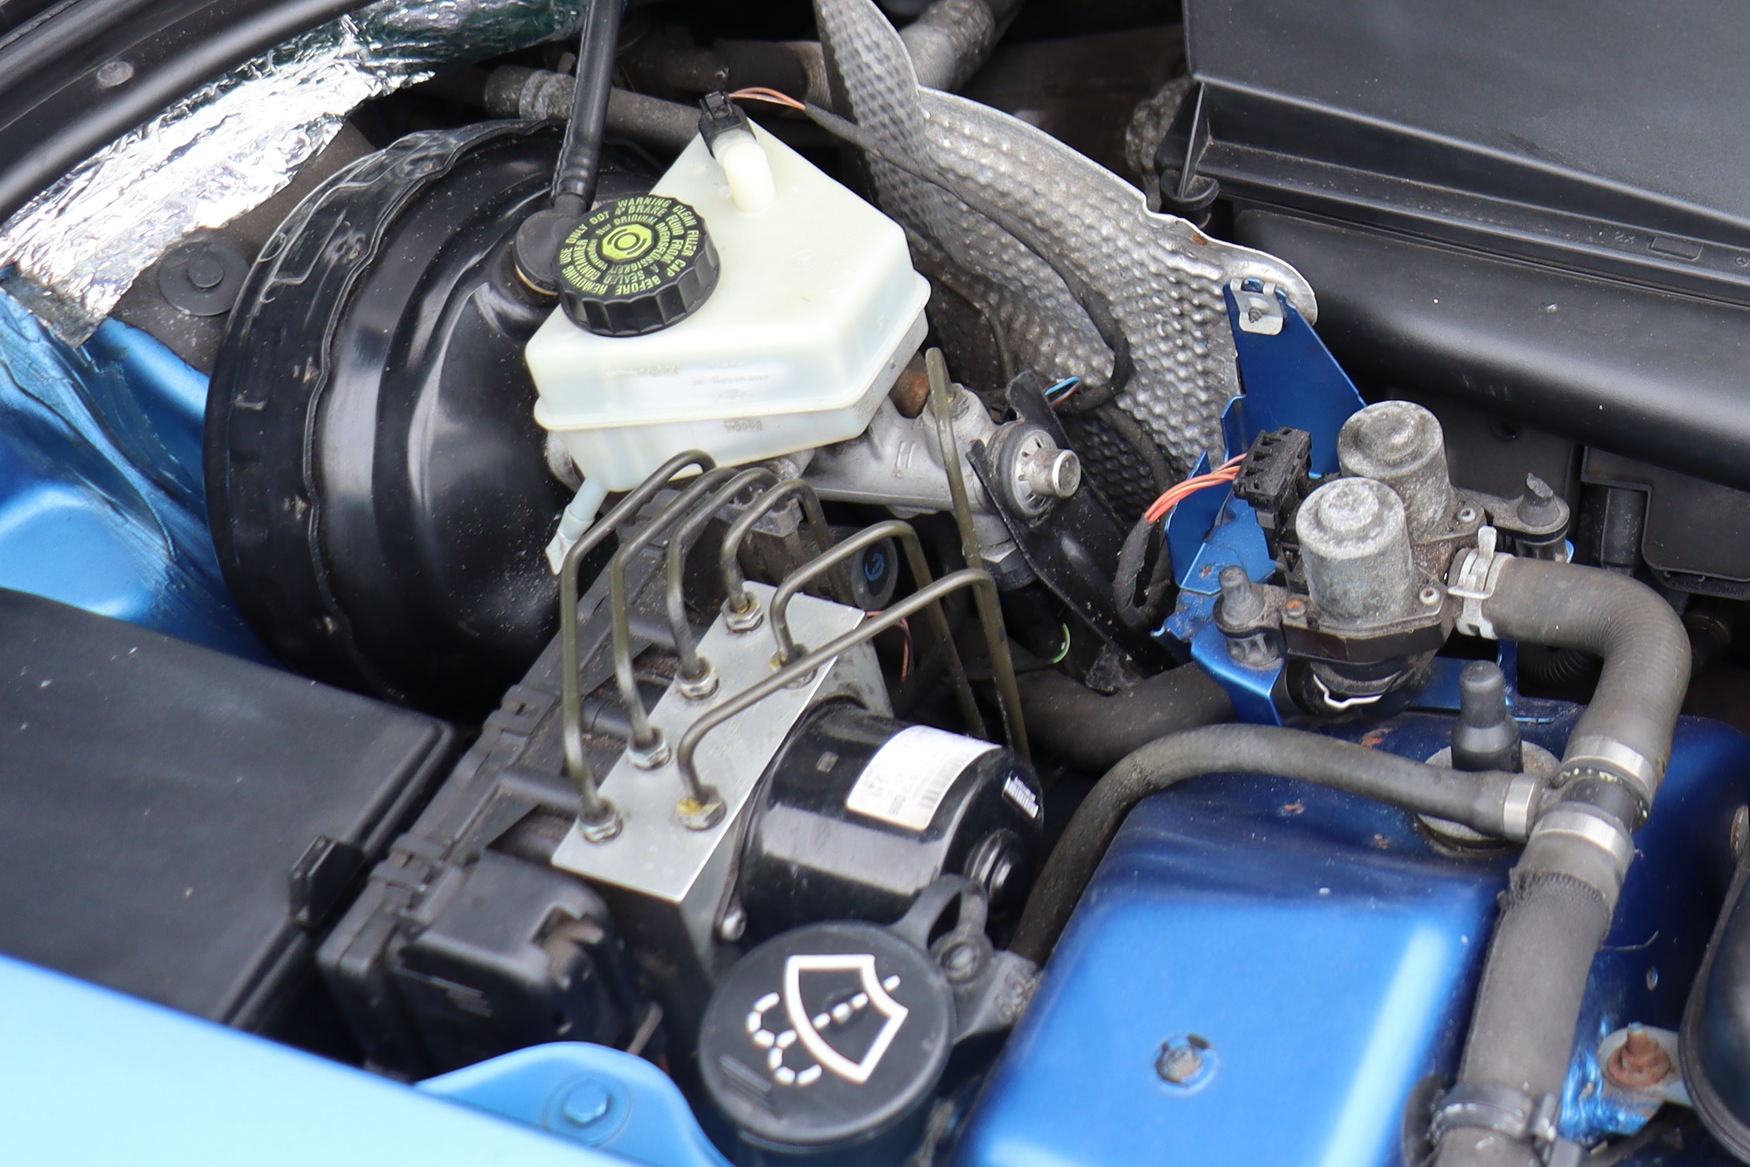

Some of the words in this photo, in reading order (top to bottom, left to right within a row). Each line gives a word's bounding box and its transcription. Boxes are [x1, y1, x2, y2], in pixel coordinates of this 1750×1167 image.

[617, 197, 671, 208] WARNING
[628, 204, 667, 217] BRAKE
[589, 210, 609, 224] DOT
[613, 214, 658, 225] ORIGINAL
[666, 215, 684, 235] FLUID
[672, 205, 697, 227] CLEAN
[565, 224, 588, 243] ONLY
[681, 230, 699, 256] FILLER
[560, 247, 573, 265] USE
[573, 239, 601, 281] CONTAINER
[660, 239, 684, 264] FROM
[603, 270, 645, 285] SEALED
[667, 259, 686, 277] CAP
[562, 265, 608, 295] REMOVING
[615, 275, 661, 296] BEFORE
